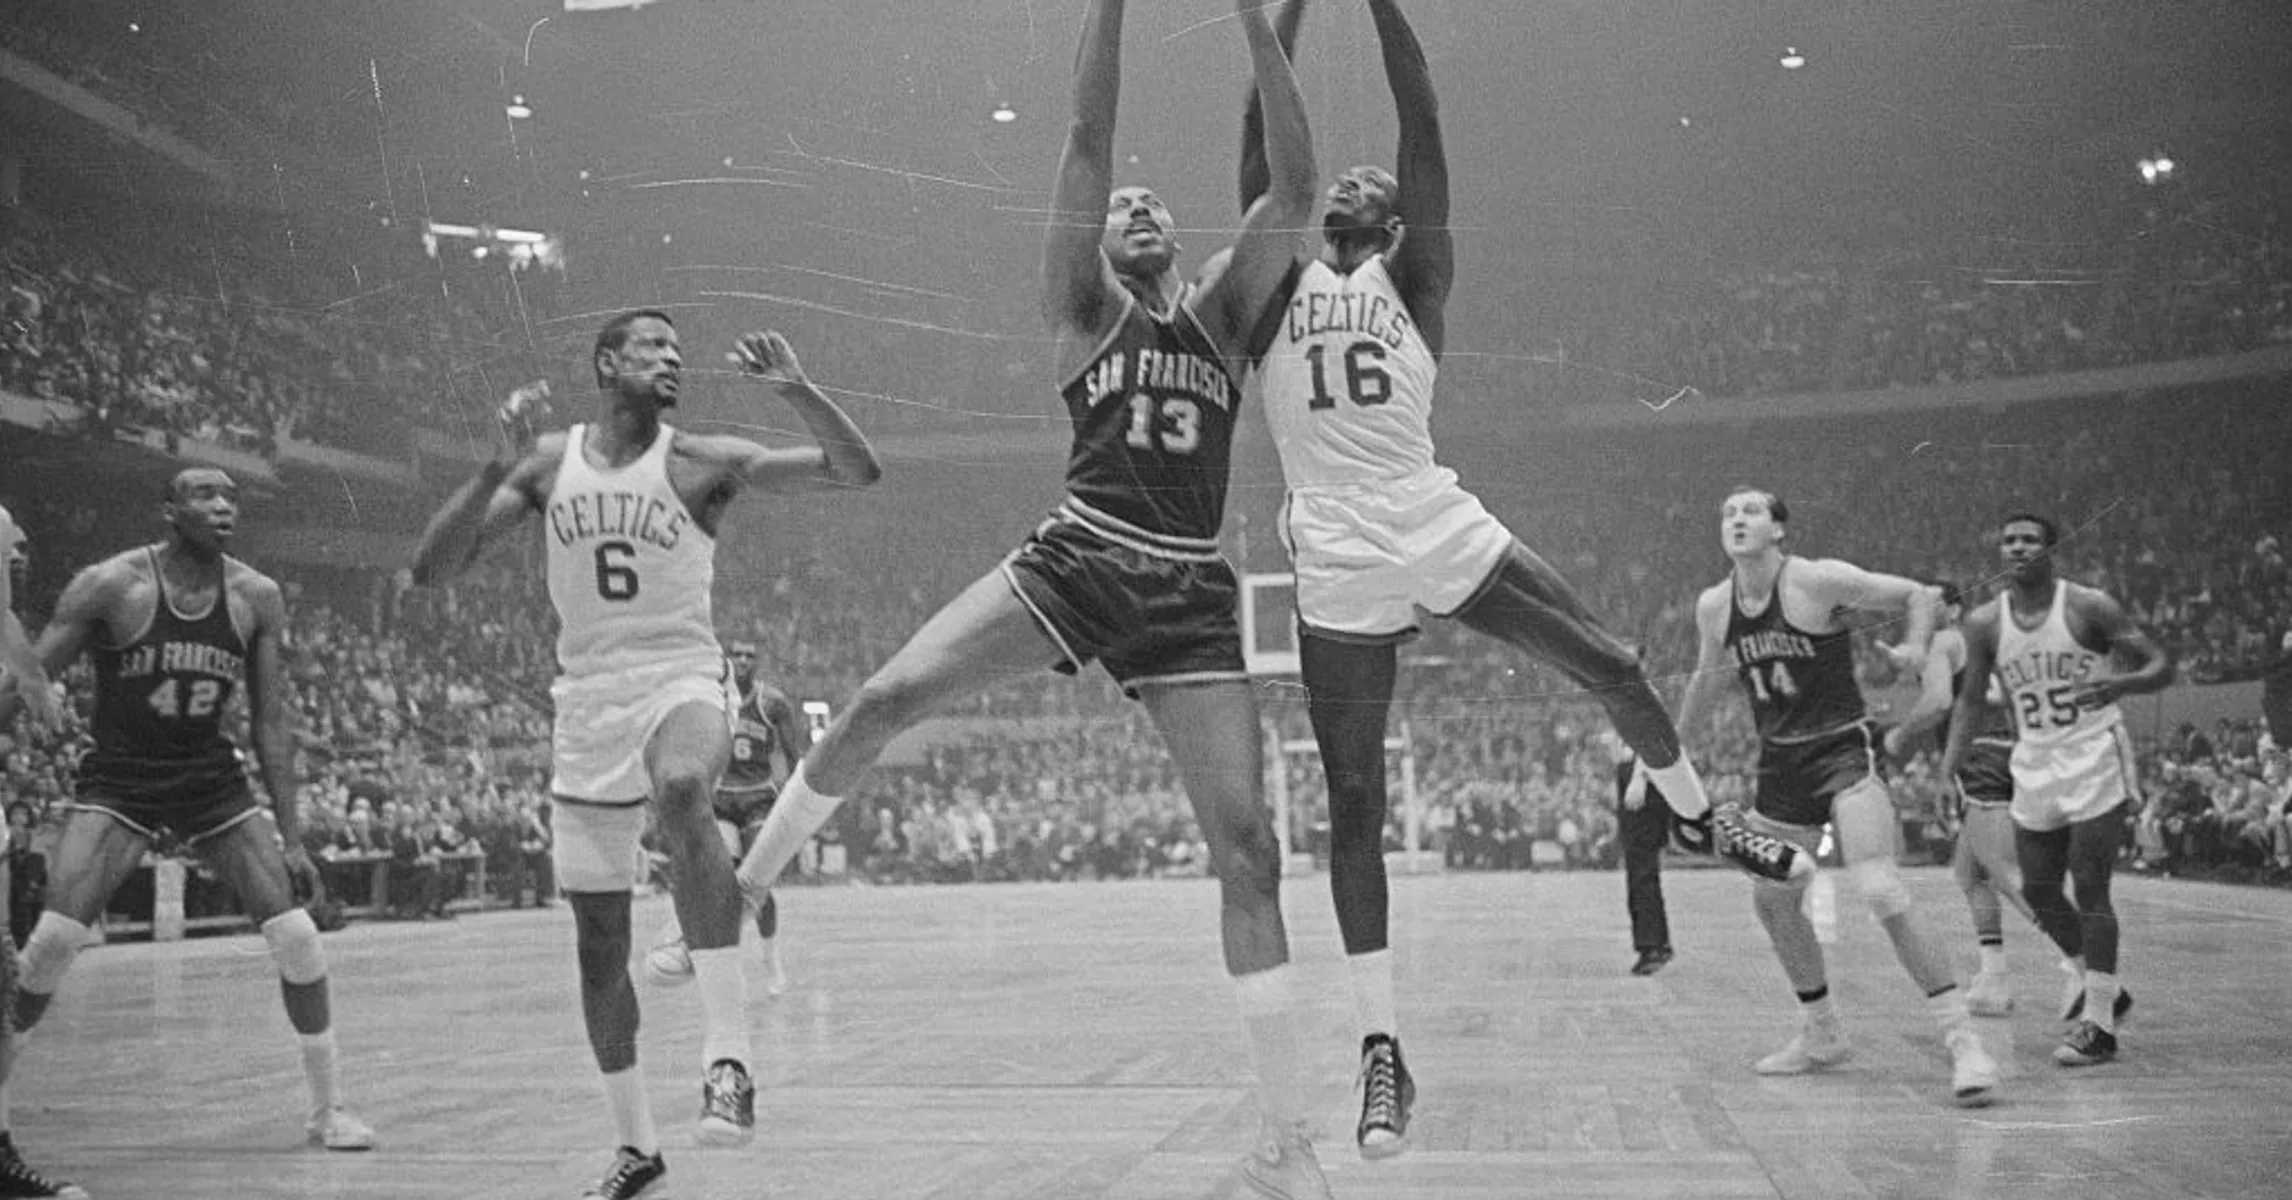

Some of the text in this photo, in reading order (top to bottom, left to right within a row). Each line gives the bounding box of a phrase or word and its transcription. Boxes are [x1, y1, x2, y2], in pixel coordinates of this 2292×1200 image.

[1289, 292, 1408, 349] CELTICS
[1086, 352, 1125, 408] SAN
[1306, 341, 1392, 409] 16
[1126, 393, 1200, 454] 13
[551, 492, 687, 550] CELTICS
[595, 540, 639, 602] 6
[118, 645, 156, 678] SAN
[1749, 661, 1798, 701] 14
[2002, 651, 2095, 688] ELTICS
[148, 679, 220, 717] 42
[2020, 686, 2078, 729] 25
